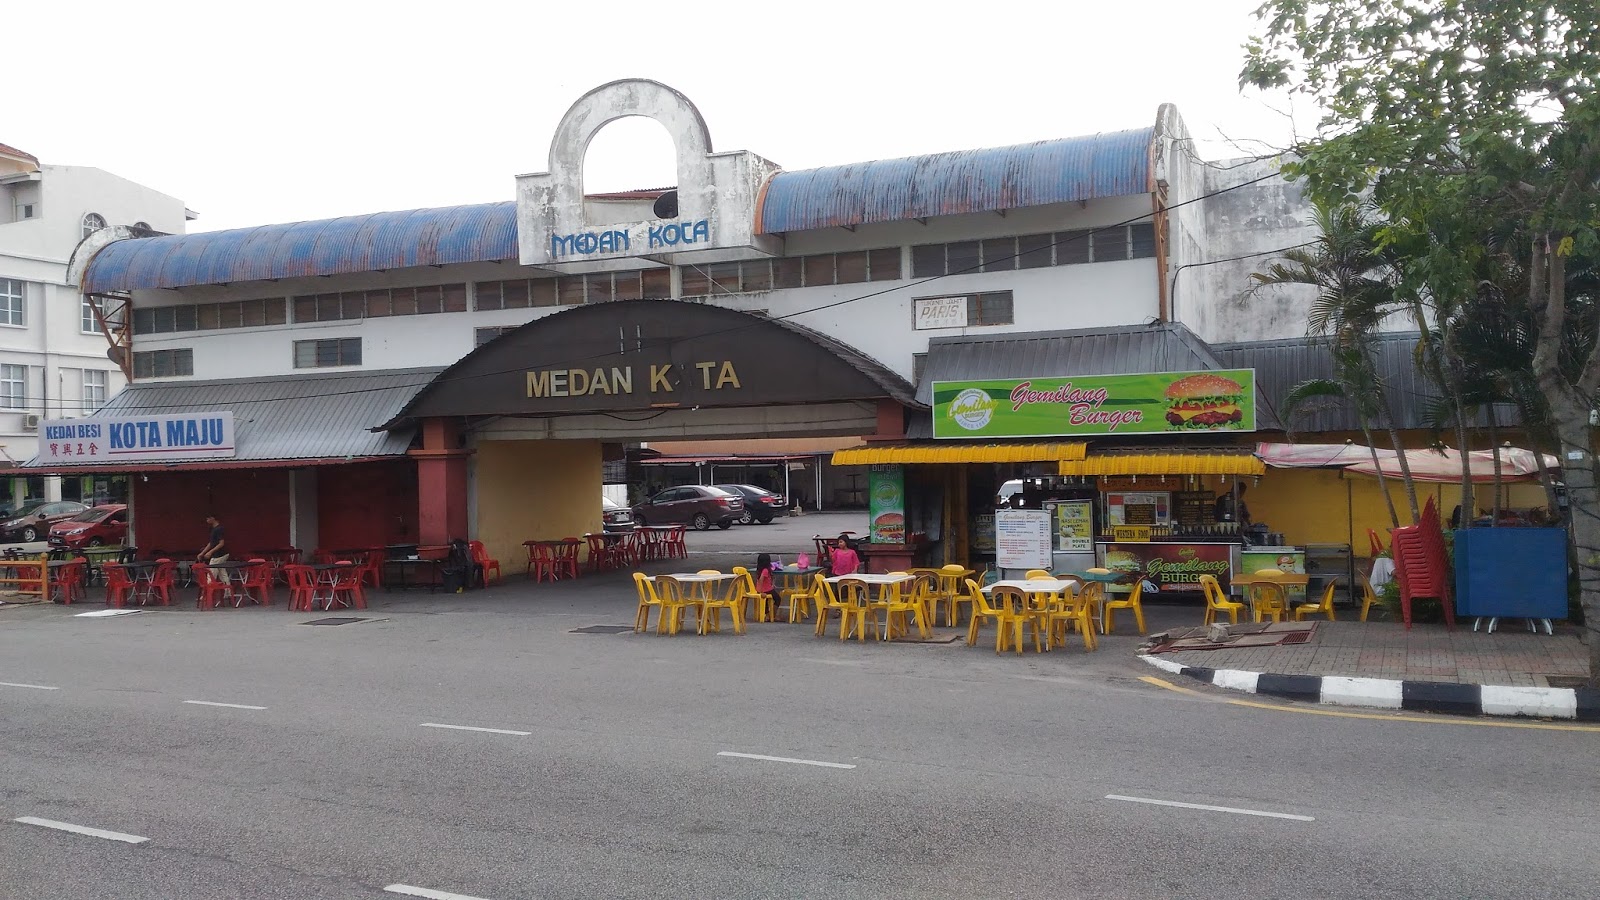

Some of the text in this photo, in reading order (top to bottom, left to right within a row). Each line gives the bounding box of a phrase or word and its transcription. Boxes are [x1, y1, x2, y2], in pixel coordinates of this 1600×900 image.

[551, 219, 709, 257] MEDAN KOTA
[920, 304, 959, 319] PARIS
[526, 366, 633, 398] MEDAN
[1010, 381, 1109, 412] Gemilang
[46, 423, 101, 440] KEDAI BESI
[1068, 402, 1143, 431] Burger
[109, 418, 224, 449] KOTA MAJU
[1146, 557, 1229, 578] Gemilang
